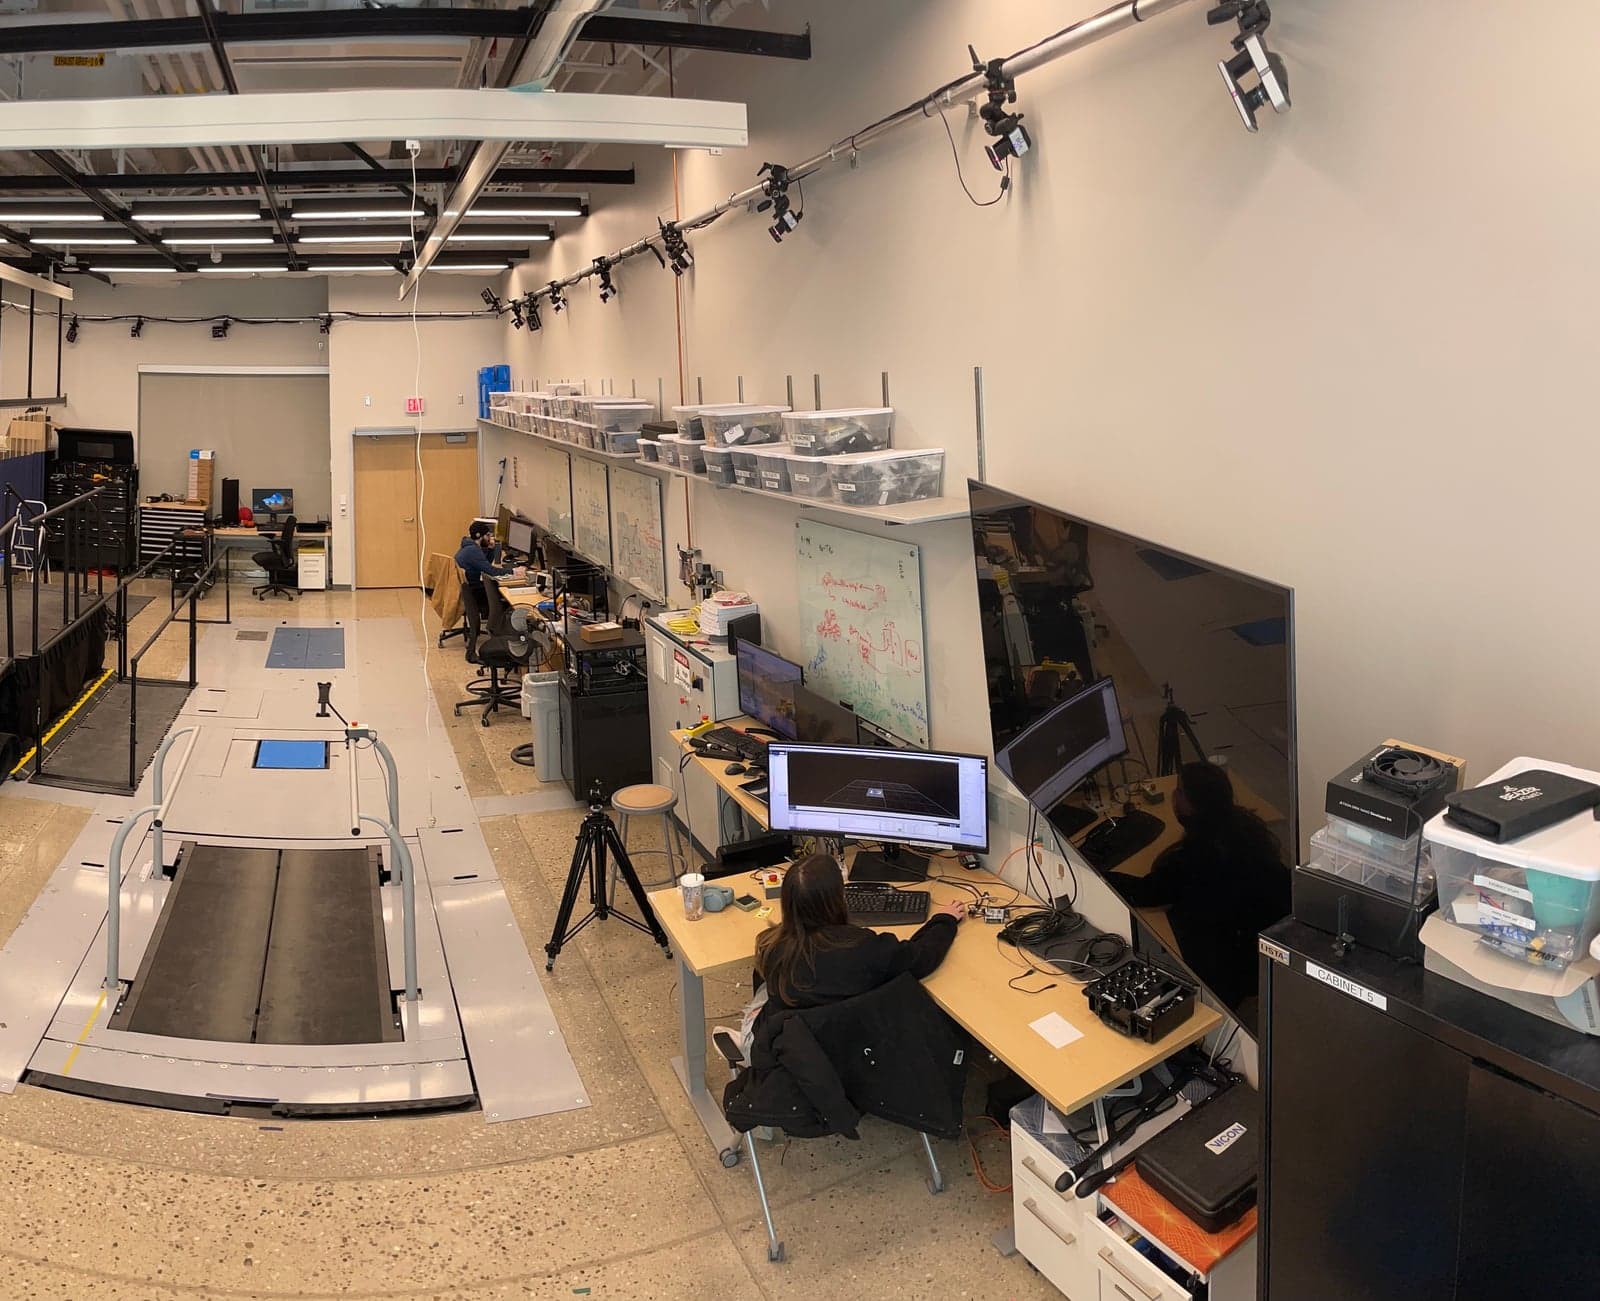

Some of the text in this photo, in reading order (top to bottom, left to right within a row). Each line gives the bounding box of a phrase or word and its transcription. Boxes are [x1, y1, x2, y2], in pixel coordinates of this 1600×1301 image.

[1499, 786, 1541, 801] BEAZER
[1261, 942, 1284, 960] LISTA
[1317, 968, 1374, 1003] CABINET 5
[1209, 1124, 1245, 1149] VICON
